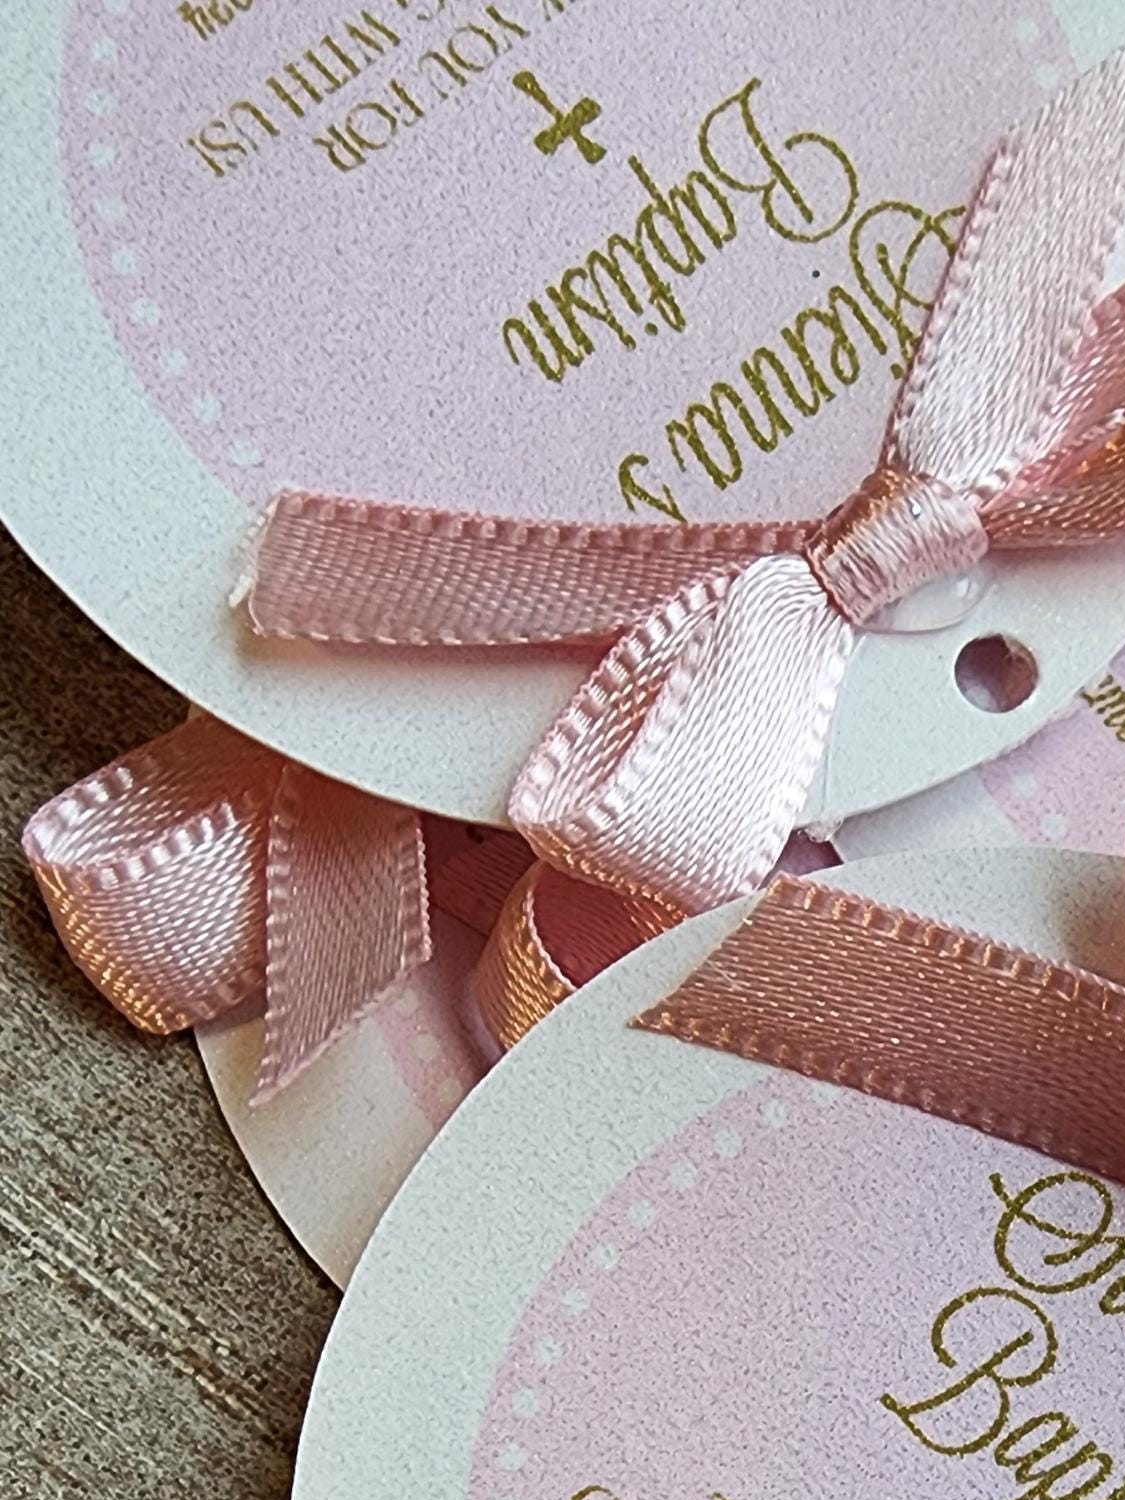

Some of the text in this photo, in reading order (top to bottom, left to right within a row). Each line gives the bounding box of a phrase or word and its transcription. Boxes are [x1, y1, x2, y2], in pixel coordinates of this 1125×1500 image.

[187, 10, 402, 178] WITH US!
[312, 78, 425, 172] FOR
[502, 77, 858, 382] Baptism
